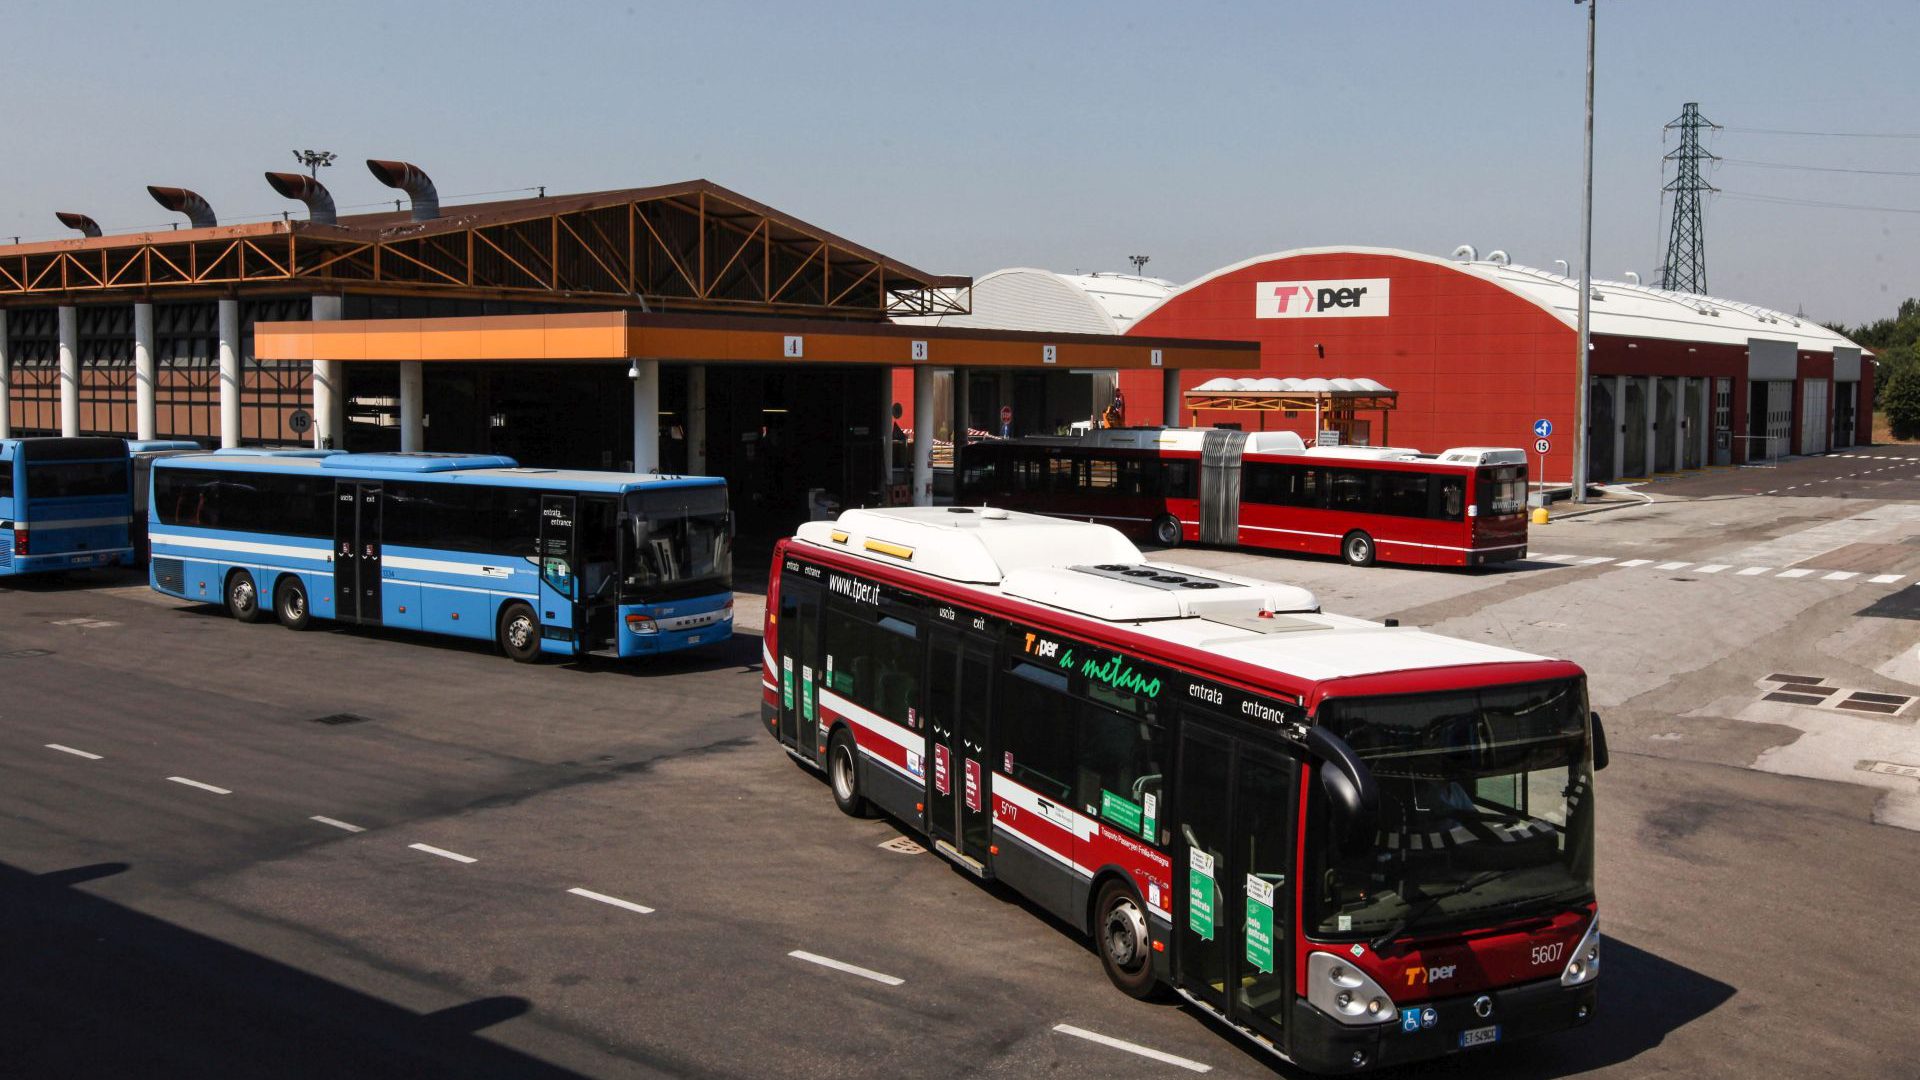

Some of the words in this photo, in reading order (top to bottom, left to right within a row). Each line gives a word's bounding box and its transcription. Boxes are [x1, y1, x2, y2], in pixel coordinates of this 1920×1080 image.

[789, 339, 797, 355] 4
[916, 343, 923, 357] 3
[1047, 348, 1053, 360] 2
[295, 416, 307, 427] 15
[1538, 442, 1547, 451] 15
[543, 508, 561, 516] entrata
[551, 518, 572, 527] entrance
[786, 561, 800, 572] entrata
[804, 566, 821, 578] entrance
[829, 574, 880, 605] www.tper.it
[940, 606, 955, 621] uscita
[973, 616, 985, 631] exit
[1059, 649, 1075, 668] a
[1081, 655, 1161, 698] metano
[1189, 683, 1223, 705] entrata
[1191, 898, 1210, 913] entrata
[1248, 917, 1261, 929] solo
[1248, 927, 1269, 944] entrata
[1531, 942, 1564, 965] 5607
